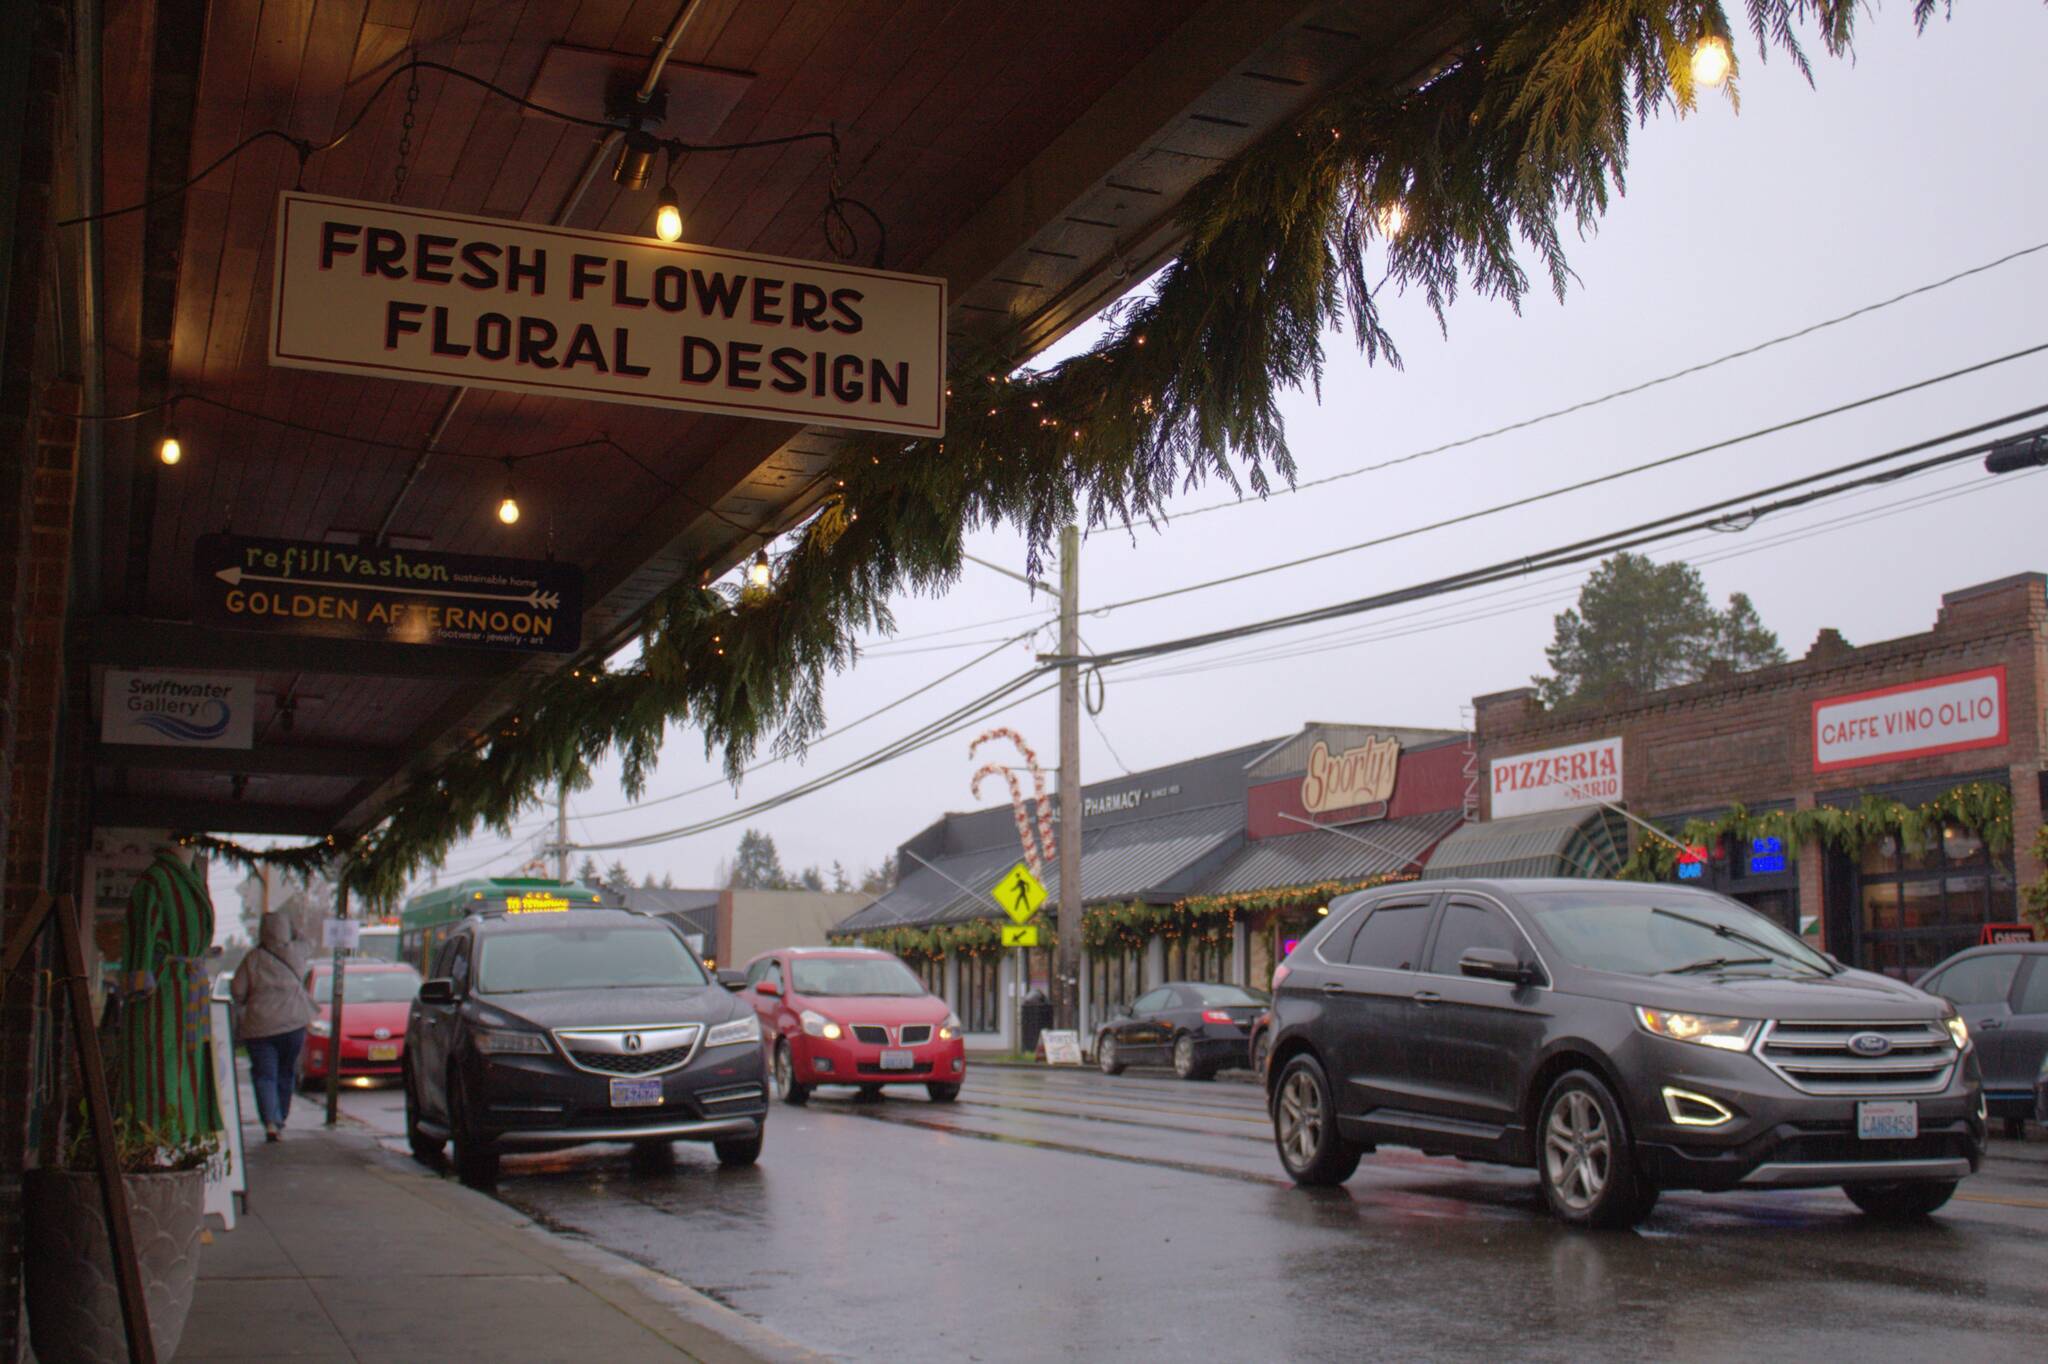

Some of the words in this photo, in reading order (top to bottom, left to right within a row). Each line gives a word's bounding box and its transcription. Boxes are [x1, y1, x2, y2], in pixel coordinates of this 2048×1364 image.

[318, 220, 547, 295] FRESH
[571, 253, 865, 335] FLOWERS
[385, 300, 652, 379] FLORAL
[681, 335, 910, 406] DESIGN
[226, 590, 359, 621] GOLDEN
[366, 602, 554, 637] AFTERNOON
[128, 679, 233, 698] Swiftwater
[128, 696, 199, 716] Gallery
[1822, 715, 1879, 744] CAFFE
[1884, 707, 1934, 735] VINO
[1939, 696, 1994, 726] OLIO
[1305, 737, 1395, 810] Sporty's
[1494, 747, 1618, 794] PIZZERIA
[1084, 790, 1142, 817] PHARMACY
